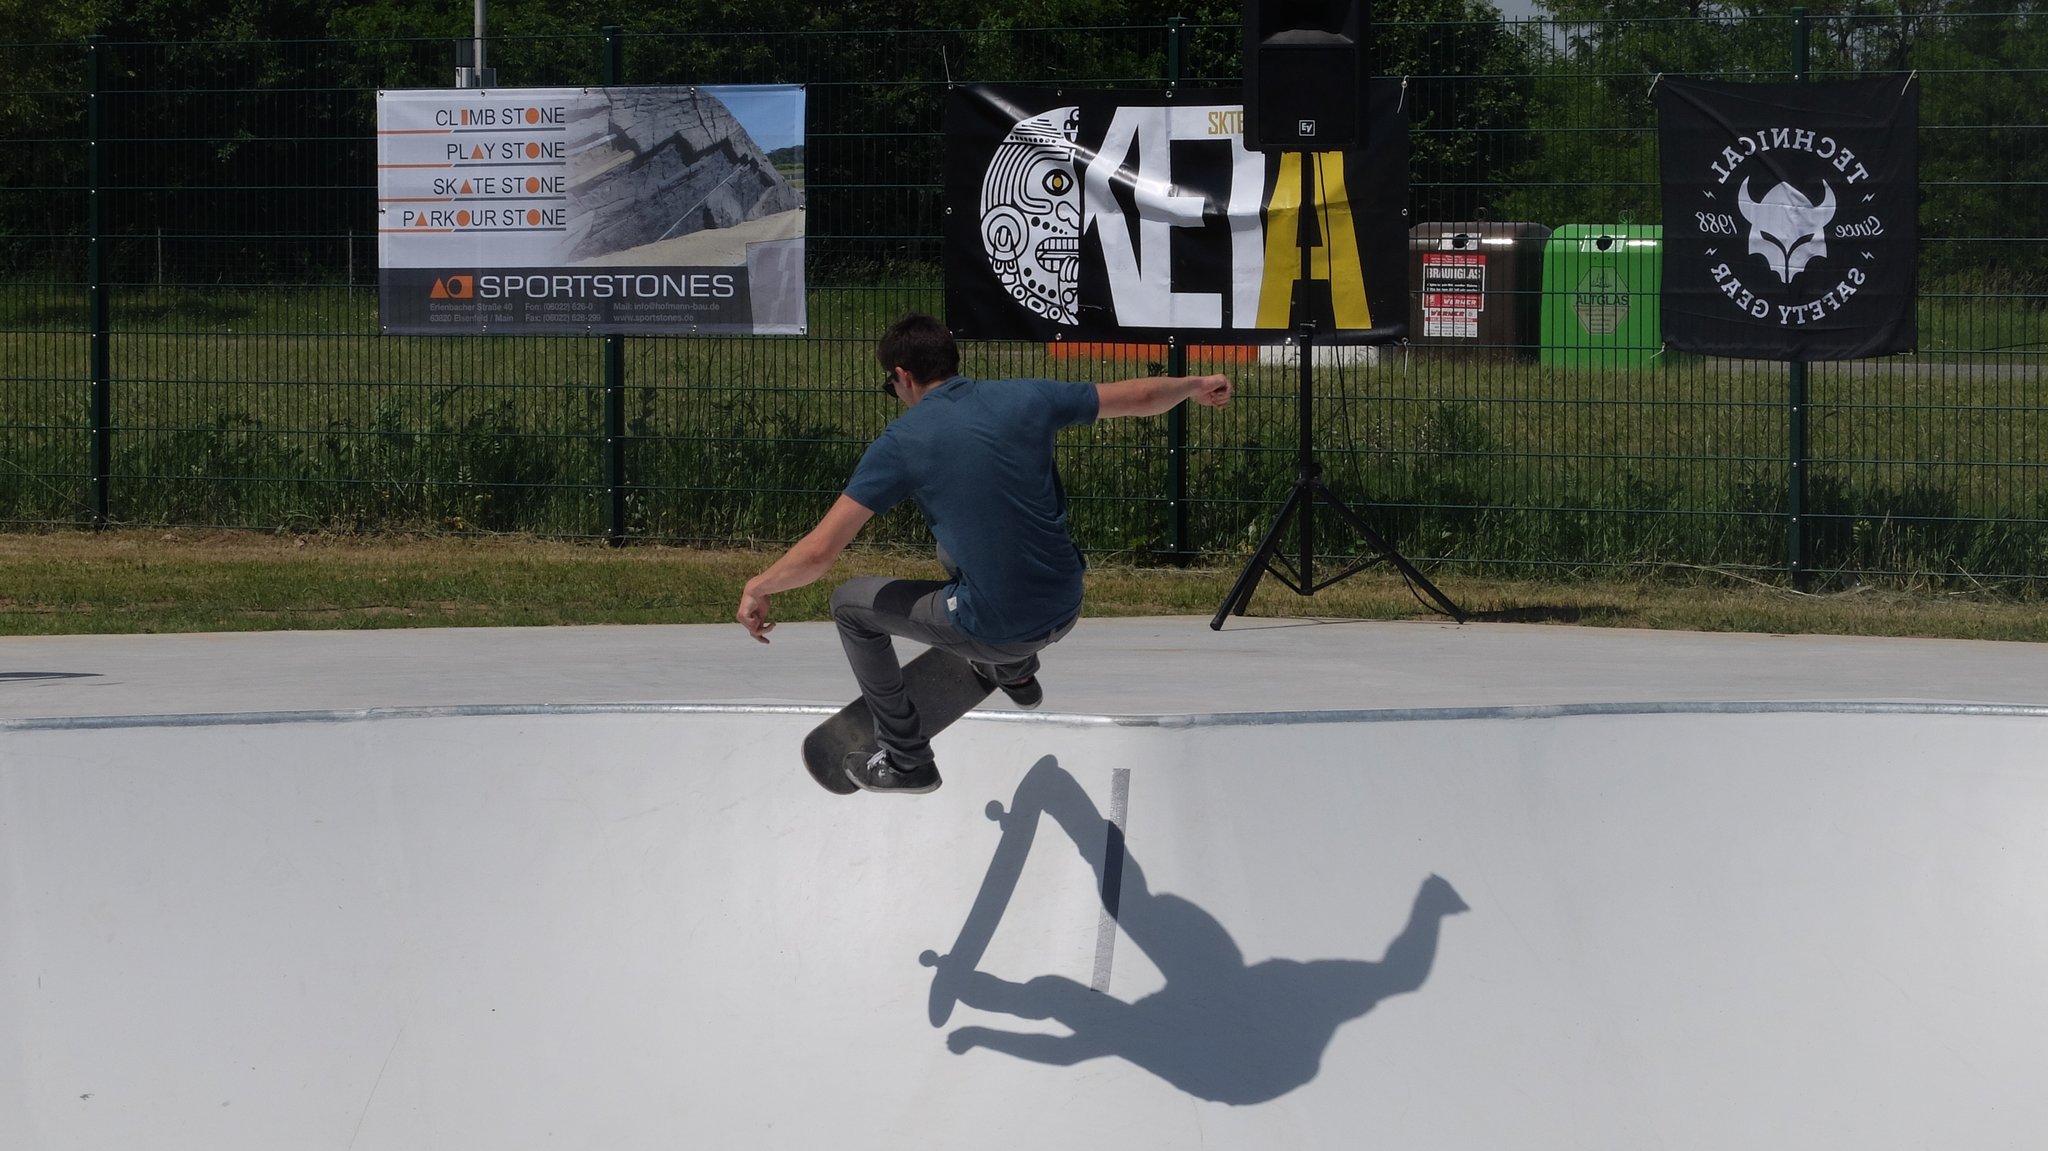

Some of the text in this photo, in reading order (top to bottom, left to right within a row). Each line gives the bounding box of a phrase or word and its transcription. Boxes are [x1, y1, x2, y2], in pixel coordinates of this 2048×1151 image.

[435, 107, 566, 127] CLIMB STONE
[446, 142, 566, 160] PLAY STONE
[433, 176, 566, 195] SKATE STONE
[403, 208, 567, 227] PARKOUR STONE
[479, 274, 735, 299] SPORTSTONES
[430, 302, 476, 312] Erlenbacher
[503, 302, 514, 311] 40
[1576, 294, 1630, 306] ALTGLAS
[495, 313, 514, 322] Main
[613, 313, 695, 324] www.sportstones.de
